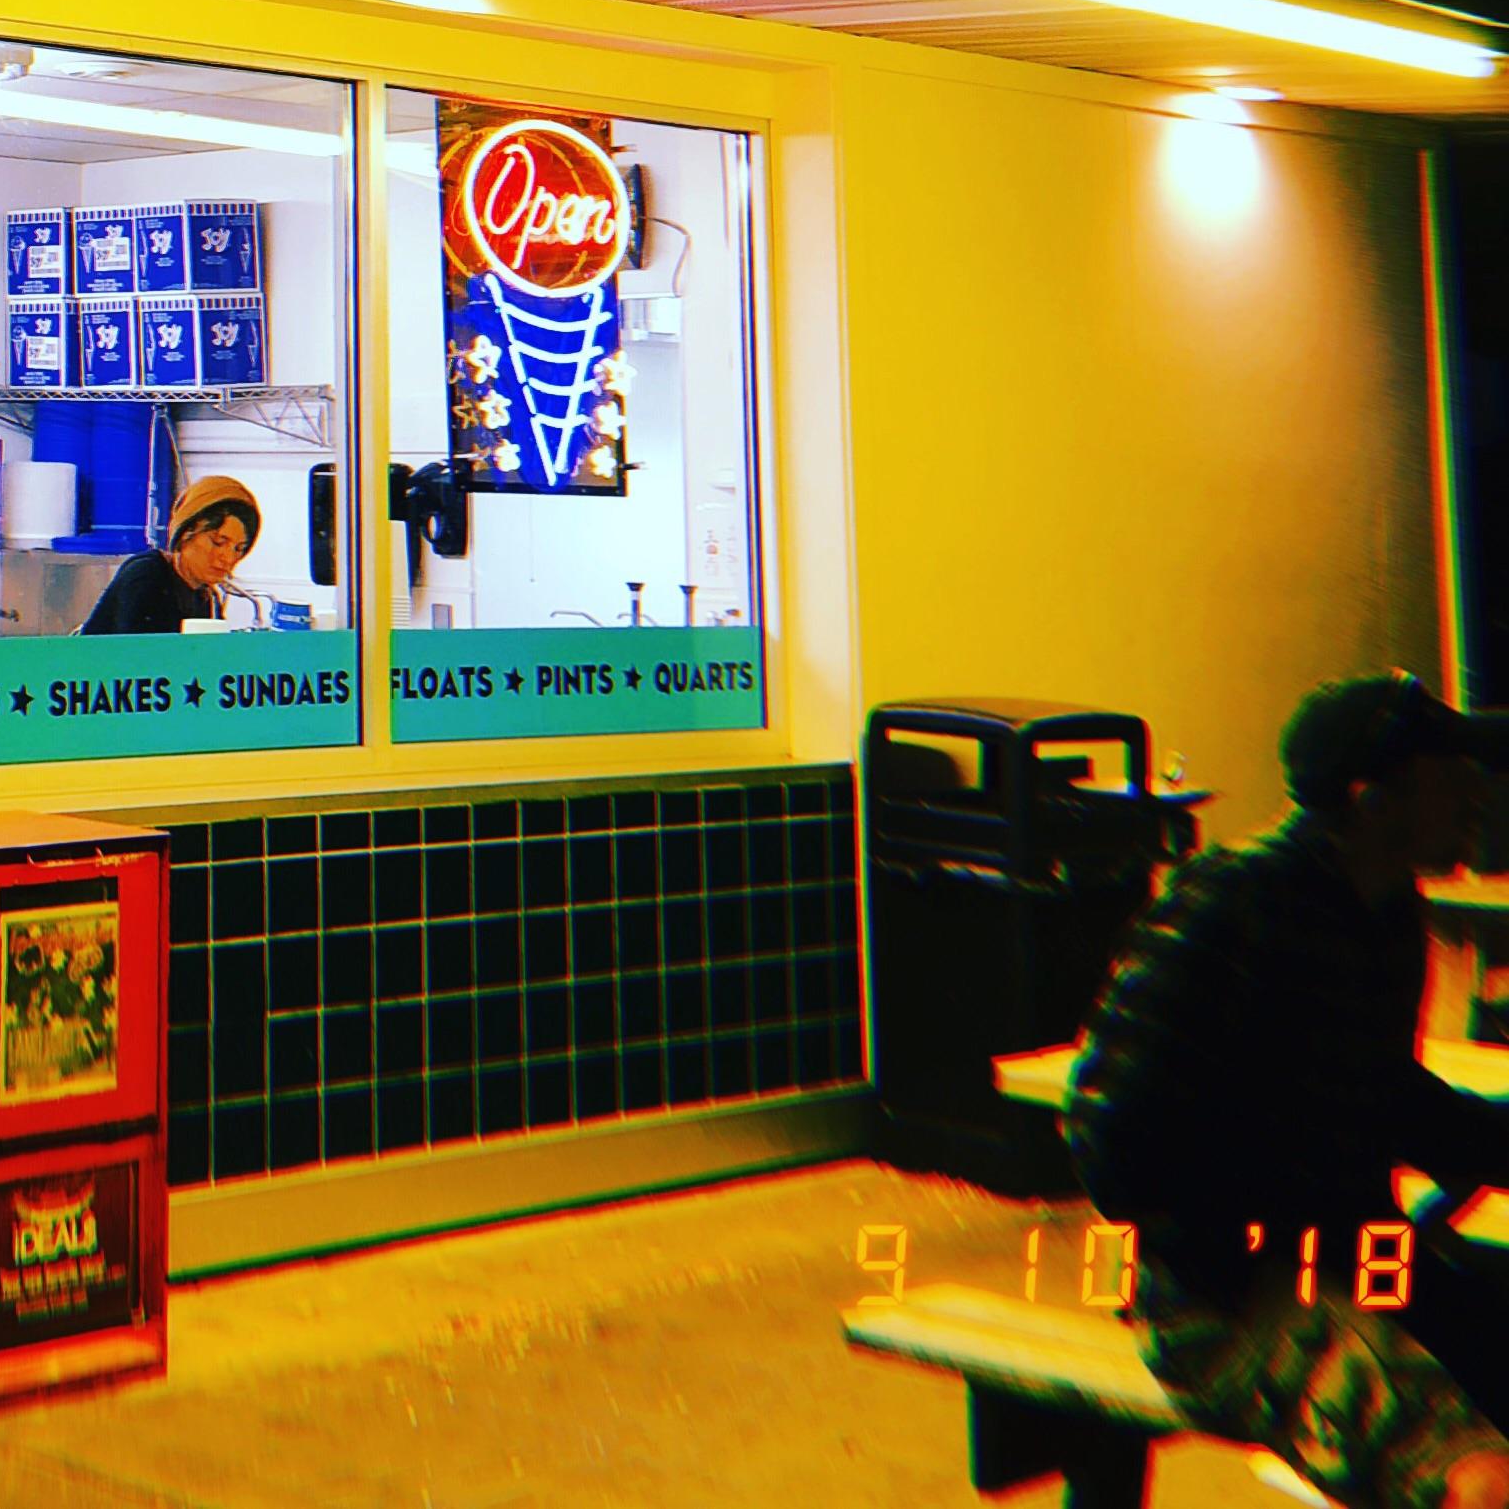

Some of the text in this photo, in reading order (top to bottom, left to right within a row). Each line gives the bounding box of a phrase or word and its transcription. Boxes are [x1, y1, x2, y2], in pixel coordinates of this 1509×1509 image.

[481, 141, 619, 268] Open
[47, 676, 172, 717] SHAKES
[218, 669, 351, 710] SUNDAES
[390, 661, 753, 700] FLOATS PINTS QUARTS
